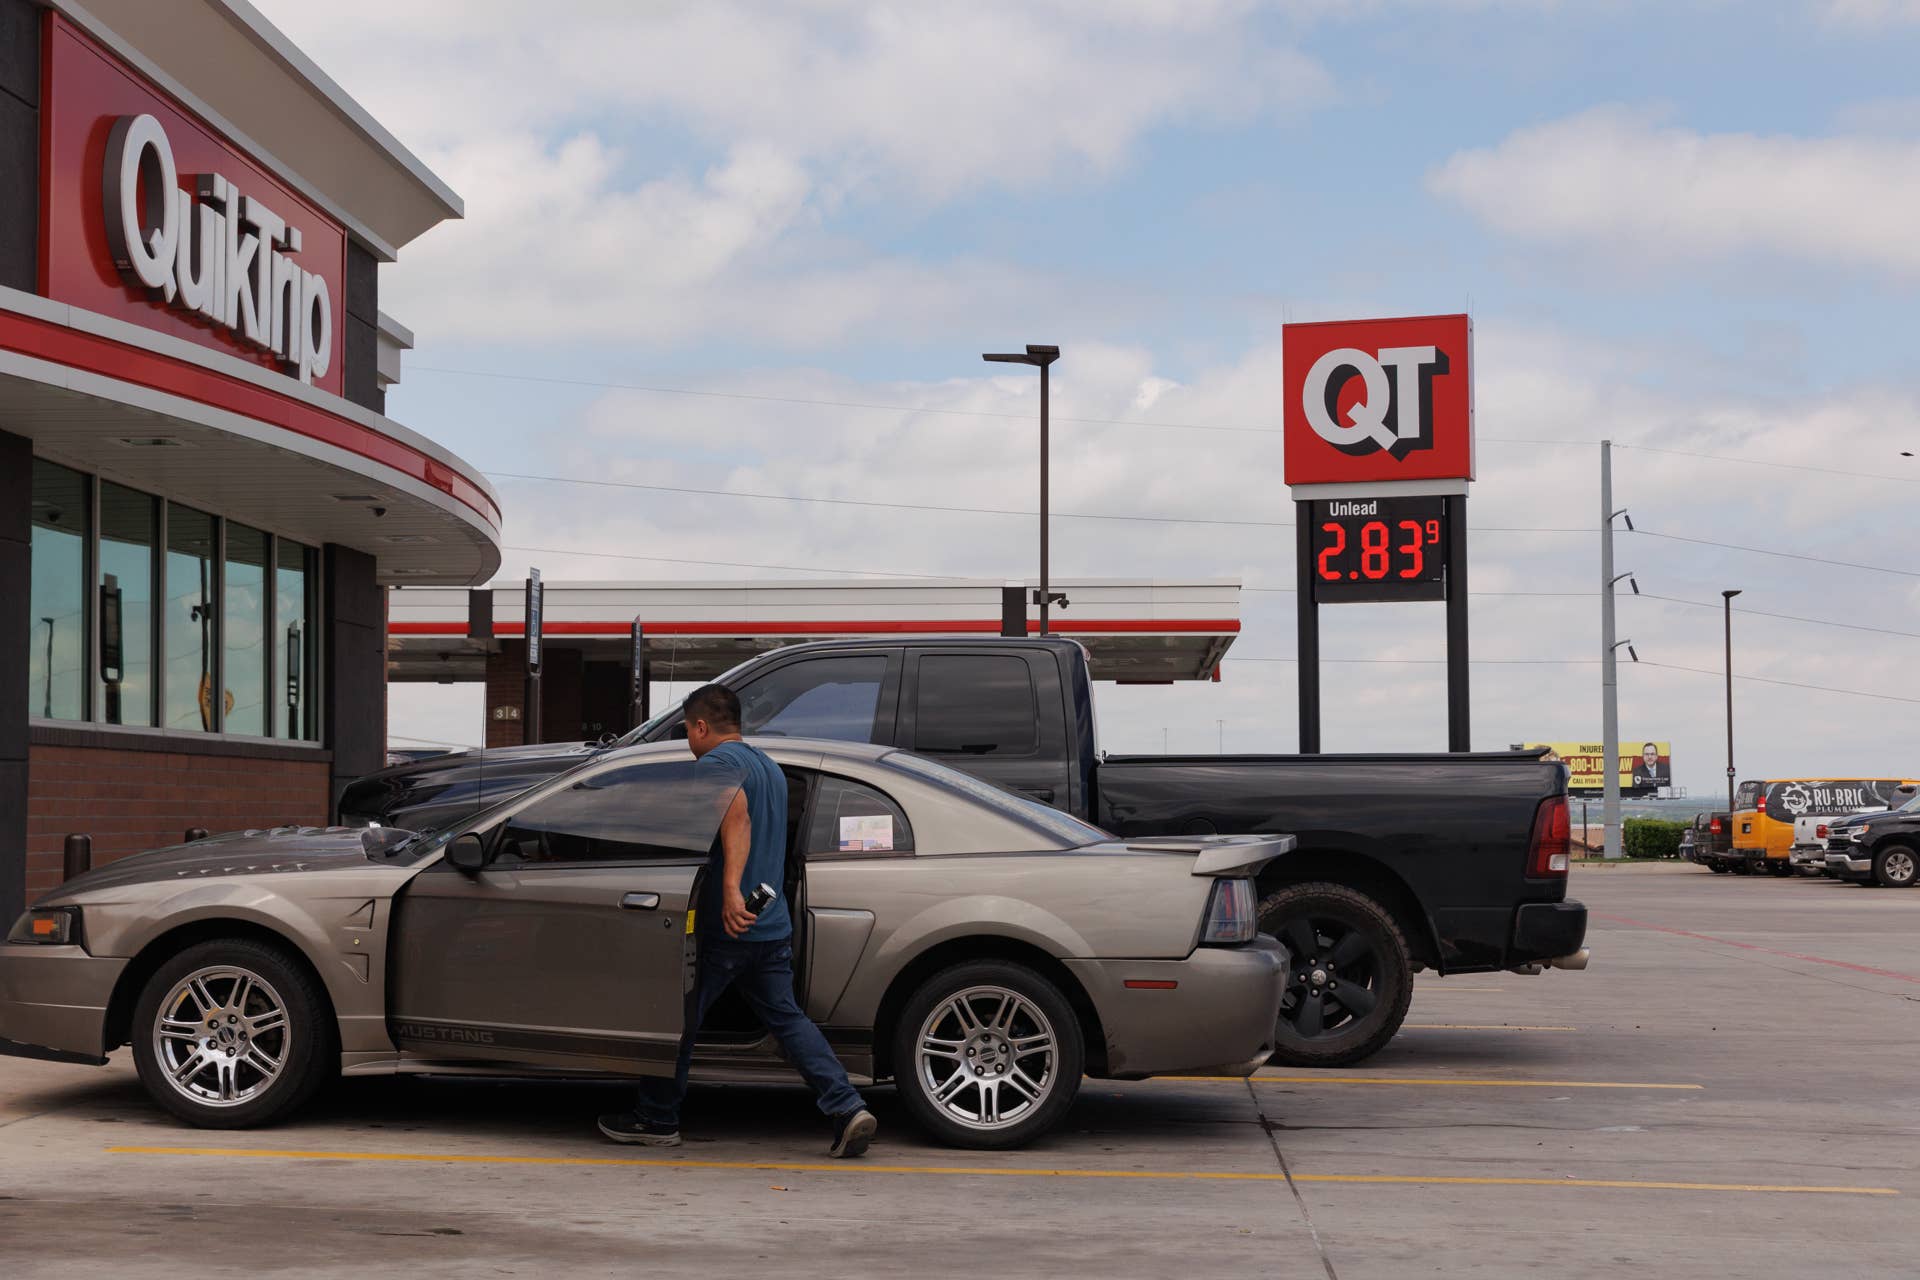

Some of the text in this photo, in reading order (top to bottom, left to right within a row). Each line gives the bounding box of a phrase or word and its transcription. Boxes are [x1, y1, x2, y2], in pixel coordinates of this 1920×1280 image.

[119, 113, 332, 386] QuikTrip
[1302, 345, 1438, 452] QT
[1329, 501, 1377, 516] Unlead
[1318, 520, 1423, 580] 2.83
[496, 708, 518, 719] 3 4
